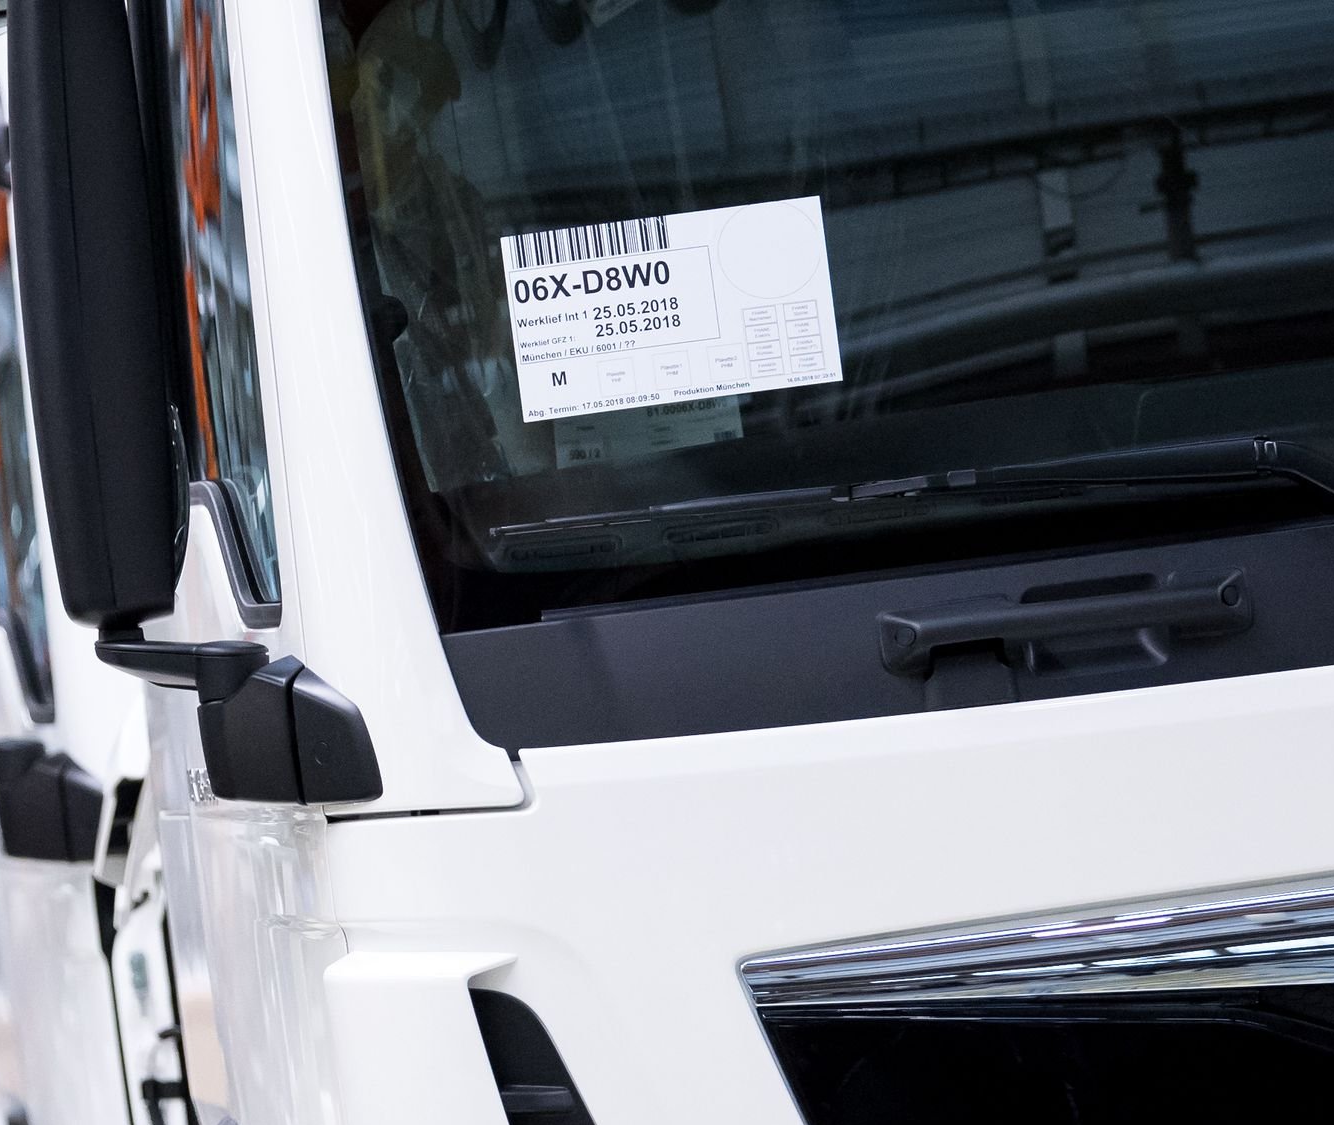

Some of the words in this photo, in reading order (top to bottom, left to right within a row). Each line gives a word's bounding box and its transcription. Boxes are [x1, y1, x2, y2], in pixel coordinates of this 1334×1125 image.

[514, 260, 670, 304] 06X-D8W0
[516, 313, 562, 328] Werklief
[564, 312, 579, 321] Int
[582, 310, 588, 319] 1
[593, 296, 679, 320] 25.05.2018
[595, 314, 681, 338] 25.05.2018
[520, 339, 550, 349] Werklief
[522, 351, 562, 362] München
[569, 347, 589, 356] EKU
[596, 343, 616, 353] 6001
[624, 339, 636, 348] ??
[551, 371, 567, 387] M
[673, 386, 714, 396] Produktion
[716, 381, 750, 391] München
[528, 409, 547, 418] Abg.
[548, 405, 580, 415] Termin:
[582, 397, 624, 409] 17.05.2018
[625, 393, 660, 403] 08:09:50
